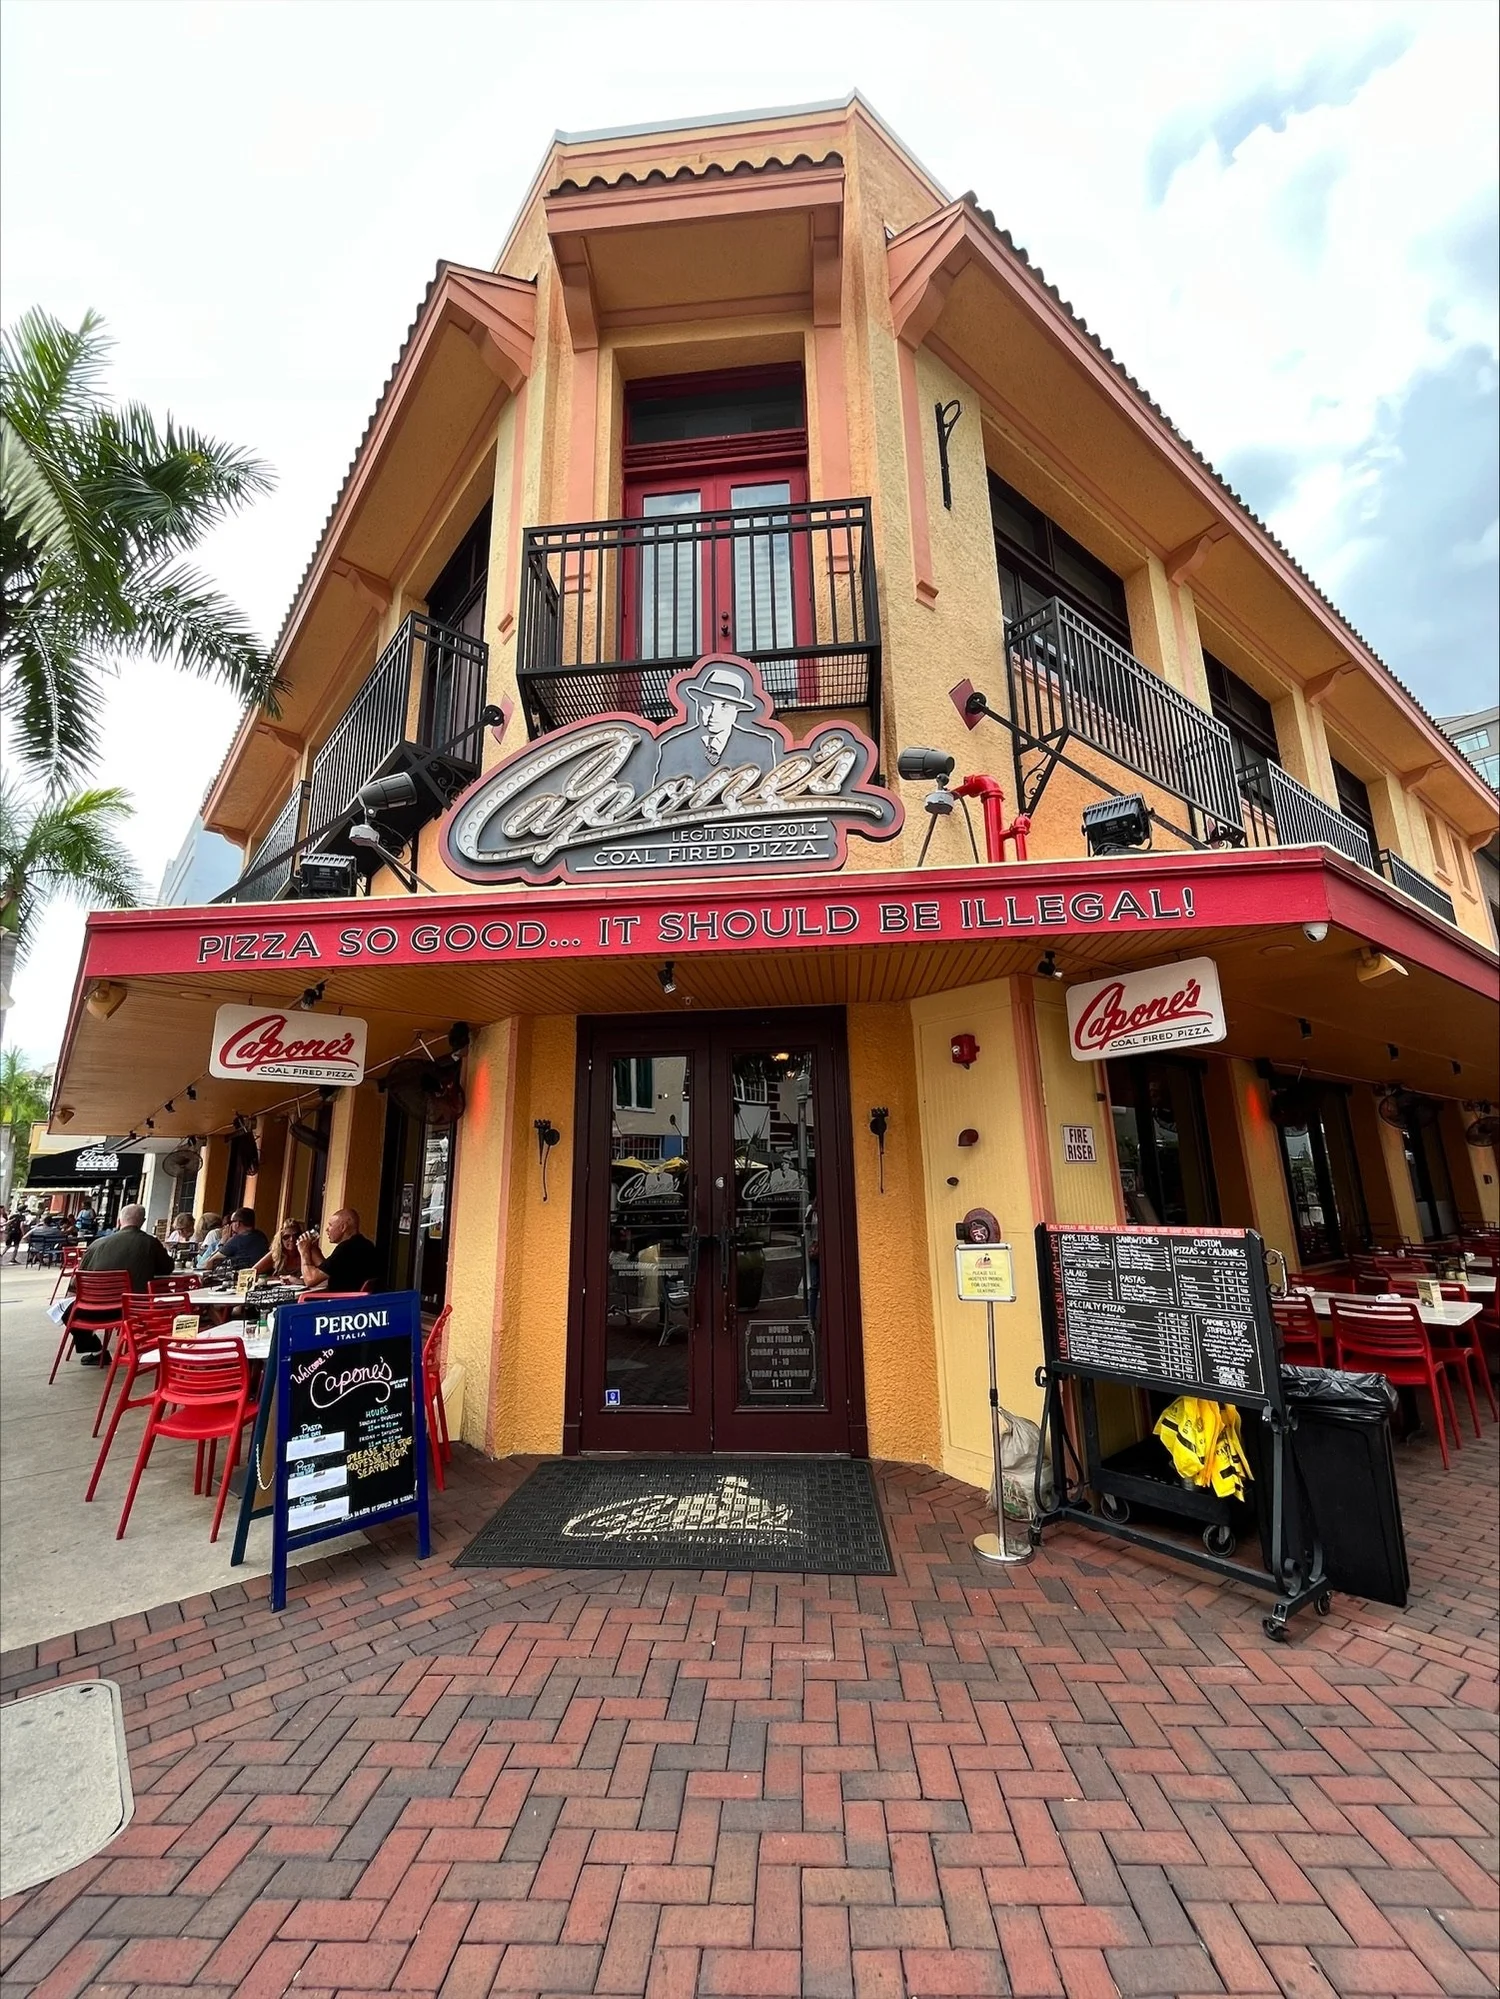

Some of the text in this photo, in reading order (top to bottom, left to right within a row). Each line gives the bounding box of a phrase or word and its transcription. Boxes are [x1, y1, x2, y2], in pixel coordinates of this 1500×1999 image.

[455, 725, 883, 866] Capone's
[672, 822, 818, 843] LEGIT SINCE 2014
[593, 840, 818, 866] COAL FIRED PIZZA
[197, 887, 1196, 963] PIZZA SO GOOD... IT SHOULD BE ILLEGAL!
[1074, 979, 1214, 1051] Capone's
[218, 1014, 359, 1070] Capone's
[1111, 1026, 1211, 1048] COAL FIRED PIZZA
[260, 1065, 355, 1079] COAL FIRED PIZZA
[1069, 1128, 1088, 1144] FIRE
[1067, 1144, 1093, 1160] RISER
[1061, 1234, 1099, 1242] APPETIZERS
[1116, 1236, 1160, 1245] SANDWICHES
[1193, 1239, 1222, 1248] CUSTOM
[1174, 1246, 1199, 1255] PIZZAS
[1207, 1248, 1246, 1257] CALZONES
[1064, 1269, 1088, 1278] SALADS
[1120, 1274, 1146, 1284] PASTAS
[1067, 1300, 1126, 1313] SPECIALTY PIZZAS
[315, 1310, 389, 1335] PERONI
[1231, 1320, 1247, 1330] BIG
[336, 1331, 366, 1341] ITALIA
[290, 1349, 334, 1385] Welcome to
[310, 1356, 392, 1409] Capone's
[365, 1405, 389, 1418] HOURS
[347, 1446, 378, 1463] PLEASE
[382, 1441, 396, 1452] SEE
